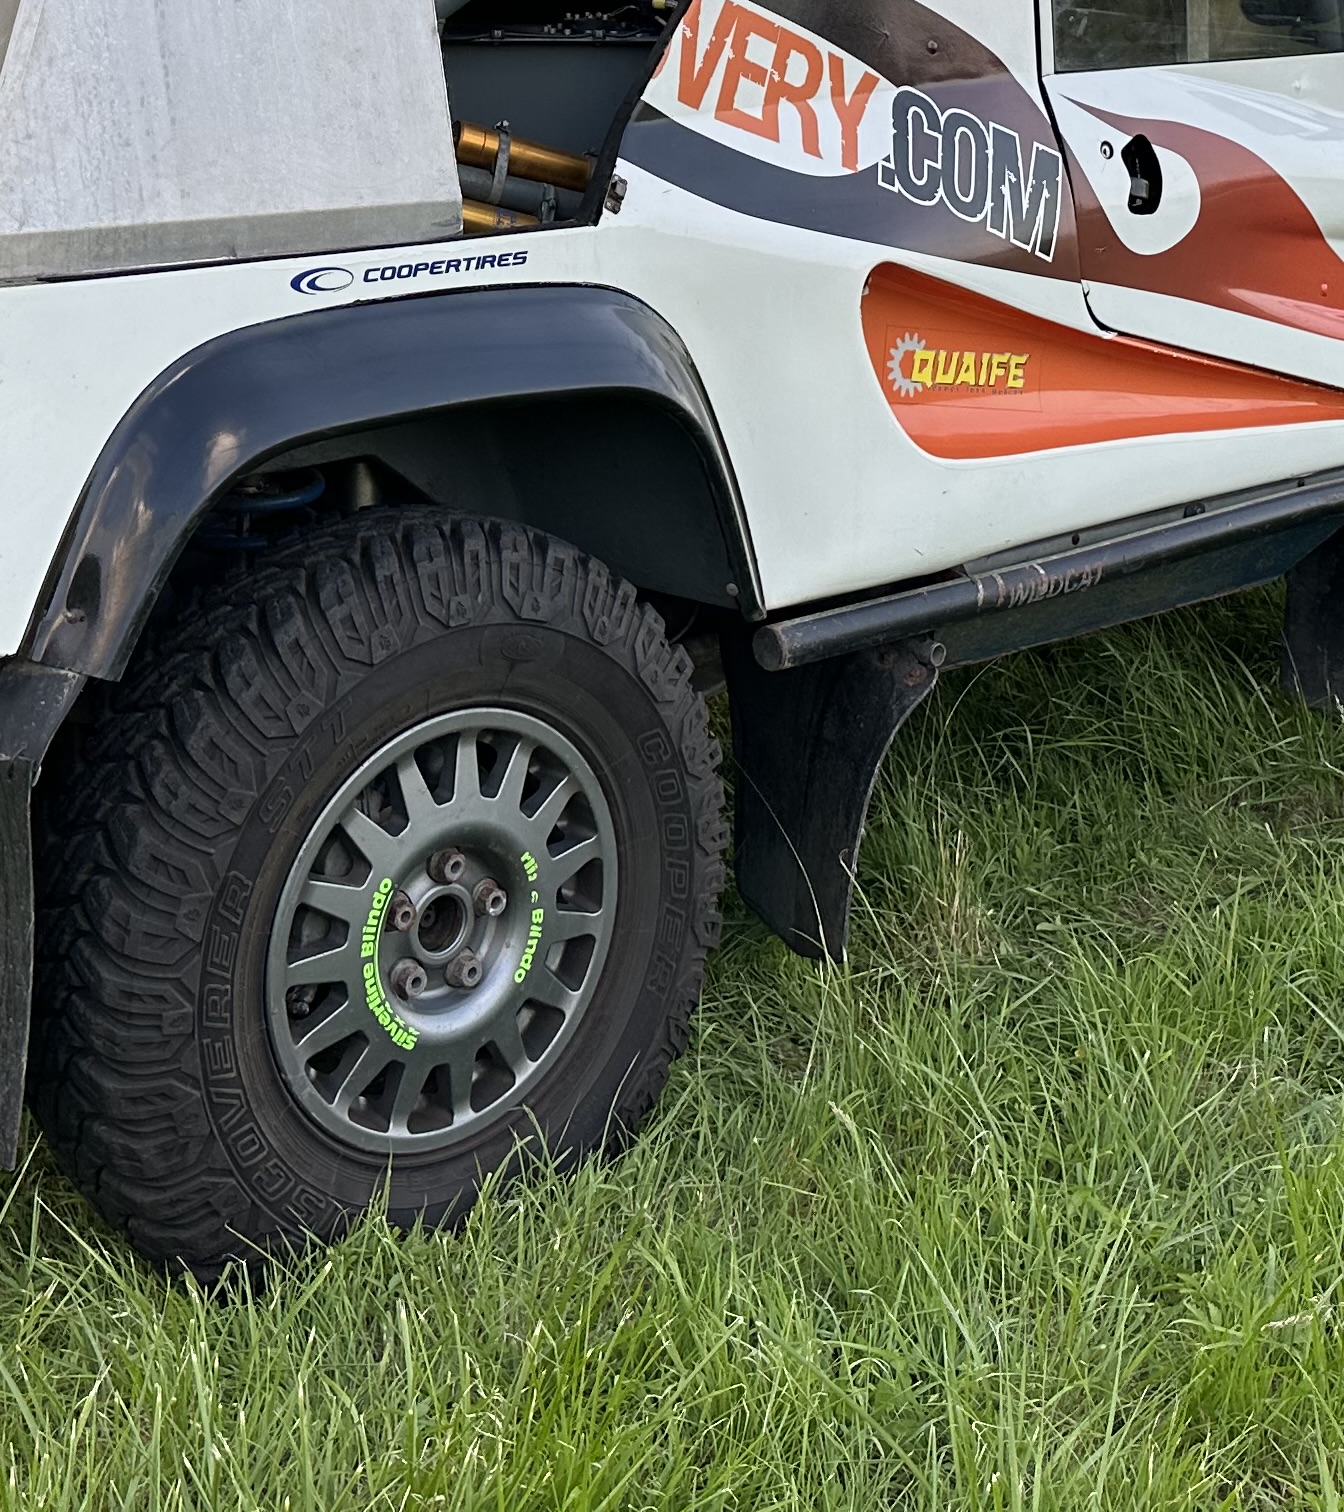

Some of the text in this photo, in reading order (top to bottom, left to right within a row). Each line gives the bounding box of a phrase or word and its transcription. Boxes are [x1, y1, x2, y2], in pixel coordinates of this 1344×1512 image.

[363, 250, 529, 283] COOPERTIRES
[911, 349, 1031, 388] QUAIFE
[258, 695, 353, 834] STT
[636, 727, 691, 1000] COOPER
[360, 877, 393, 958] Blindo
[513, 908, 544, 984] Blindo
[362, 962, 417, 1051] Silverline
